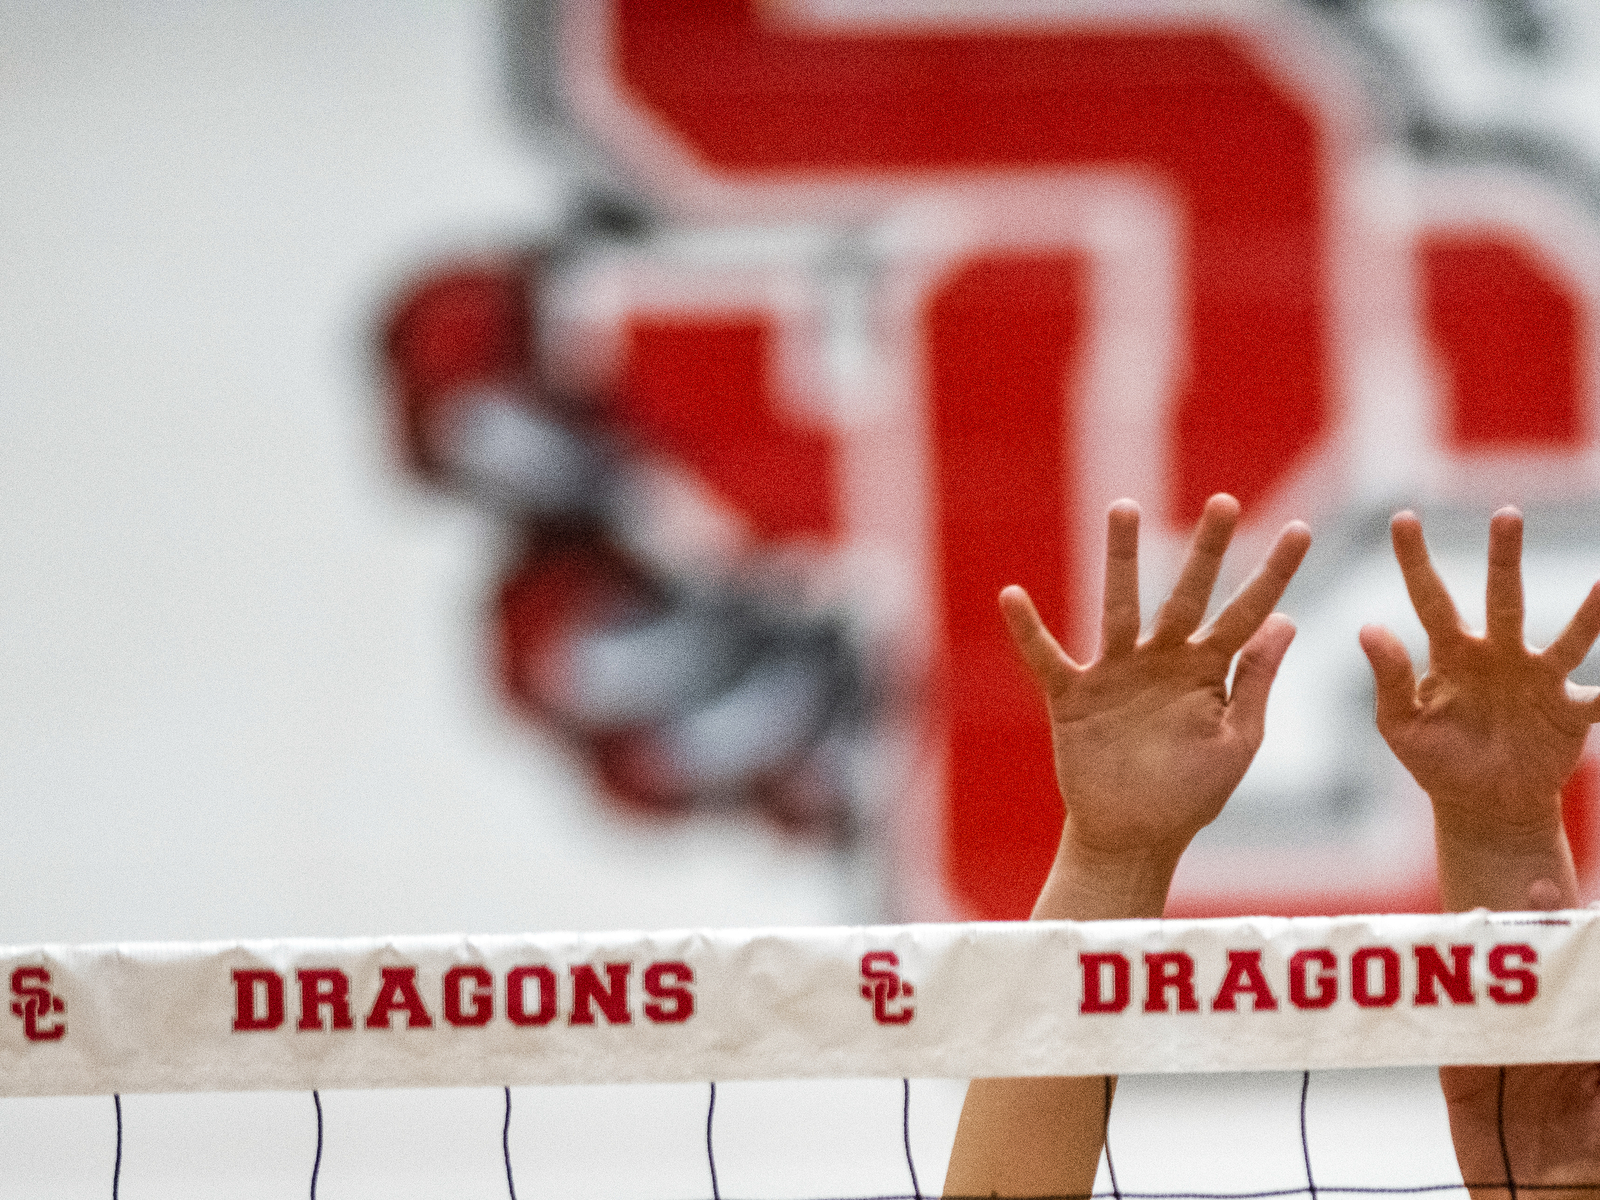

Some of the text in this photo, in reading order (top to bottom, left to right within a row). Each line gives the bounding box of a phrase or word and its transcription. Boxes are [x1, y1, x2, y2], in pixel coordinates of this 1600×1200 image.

[10, 966, 66, 1043] SC
[231, 961, 695, 1032] DRAGONS
[1078, 943, 1540, 1014] DRAGONS
